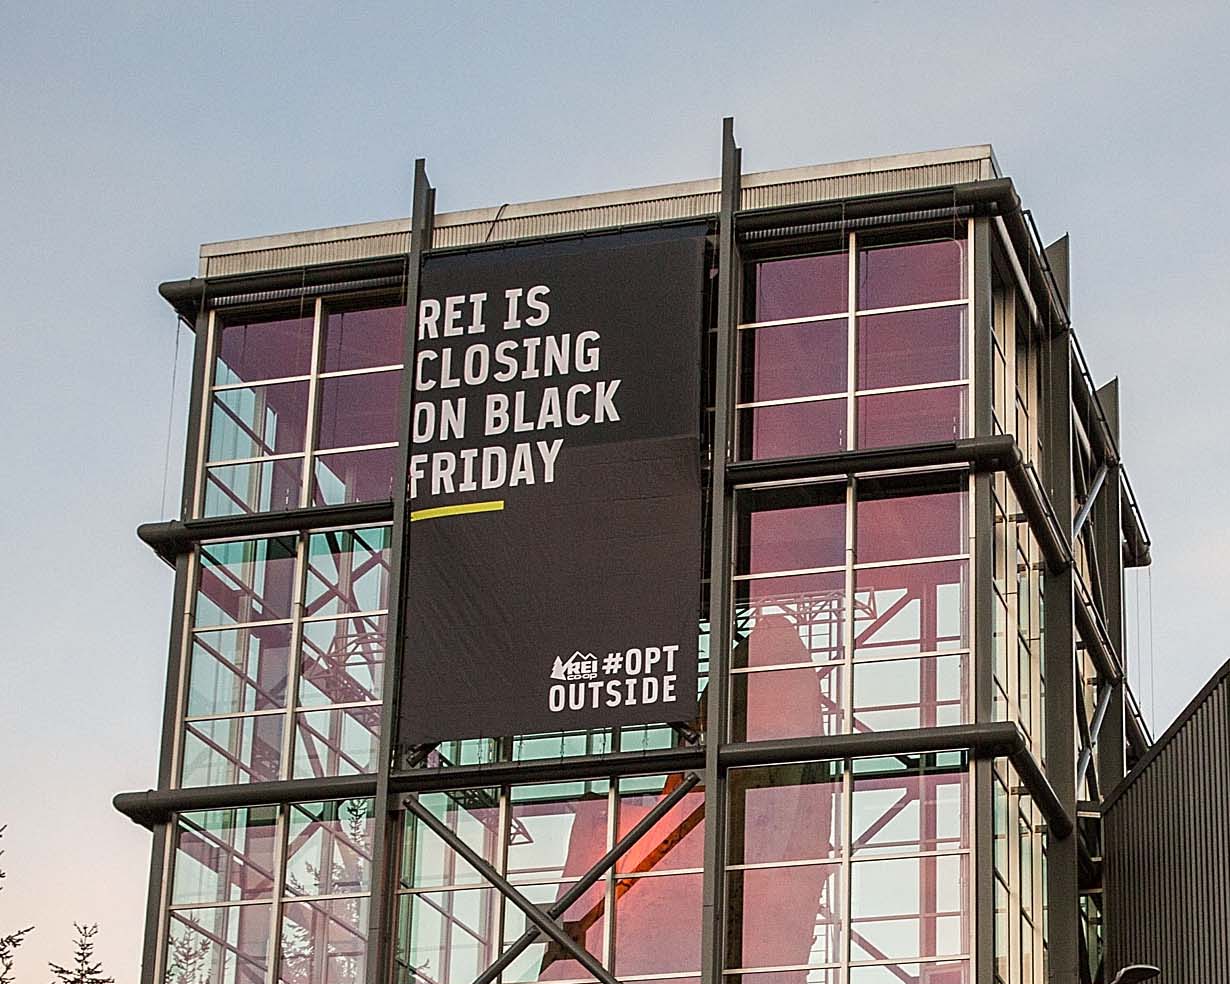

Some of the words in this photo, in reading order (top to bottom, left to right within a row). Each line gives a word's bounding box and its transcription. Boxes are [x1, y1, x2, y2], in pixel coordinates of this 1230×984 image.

[418, 292, 487, 341] REI
[503, 285, 550, 330] IS
[415, 330, 600, 391] CLOSING
[412, 397, 466, 443] ON
[484, 379, 621, 436] BLACK
[410, 438, 564, 499] FRIDAY
[602, 645, 679, 676] #OPT
[549, 675, 677, 712] OUTSIDE
